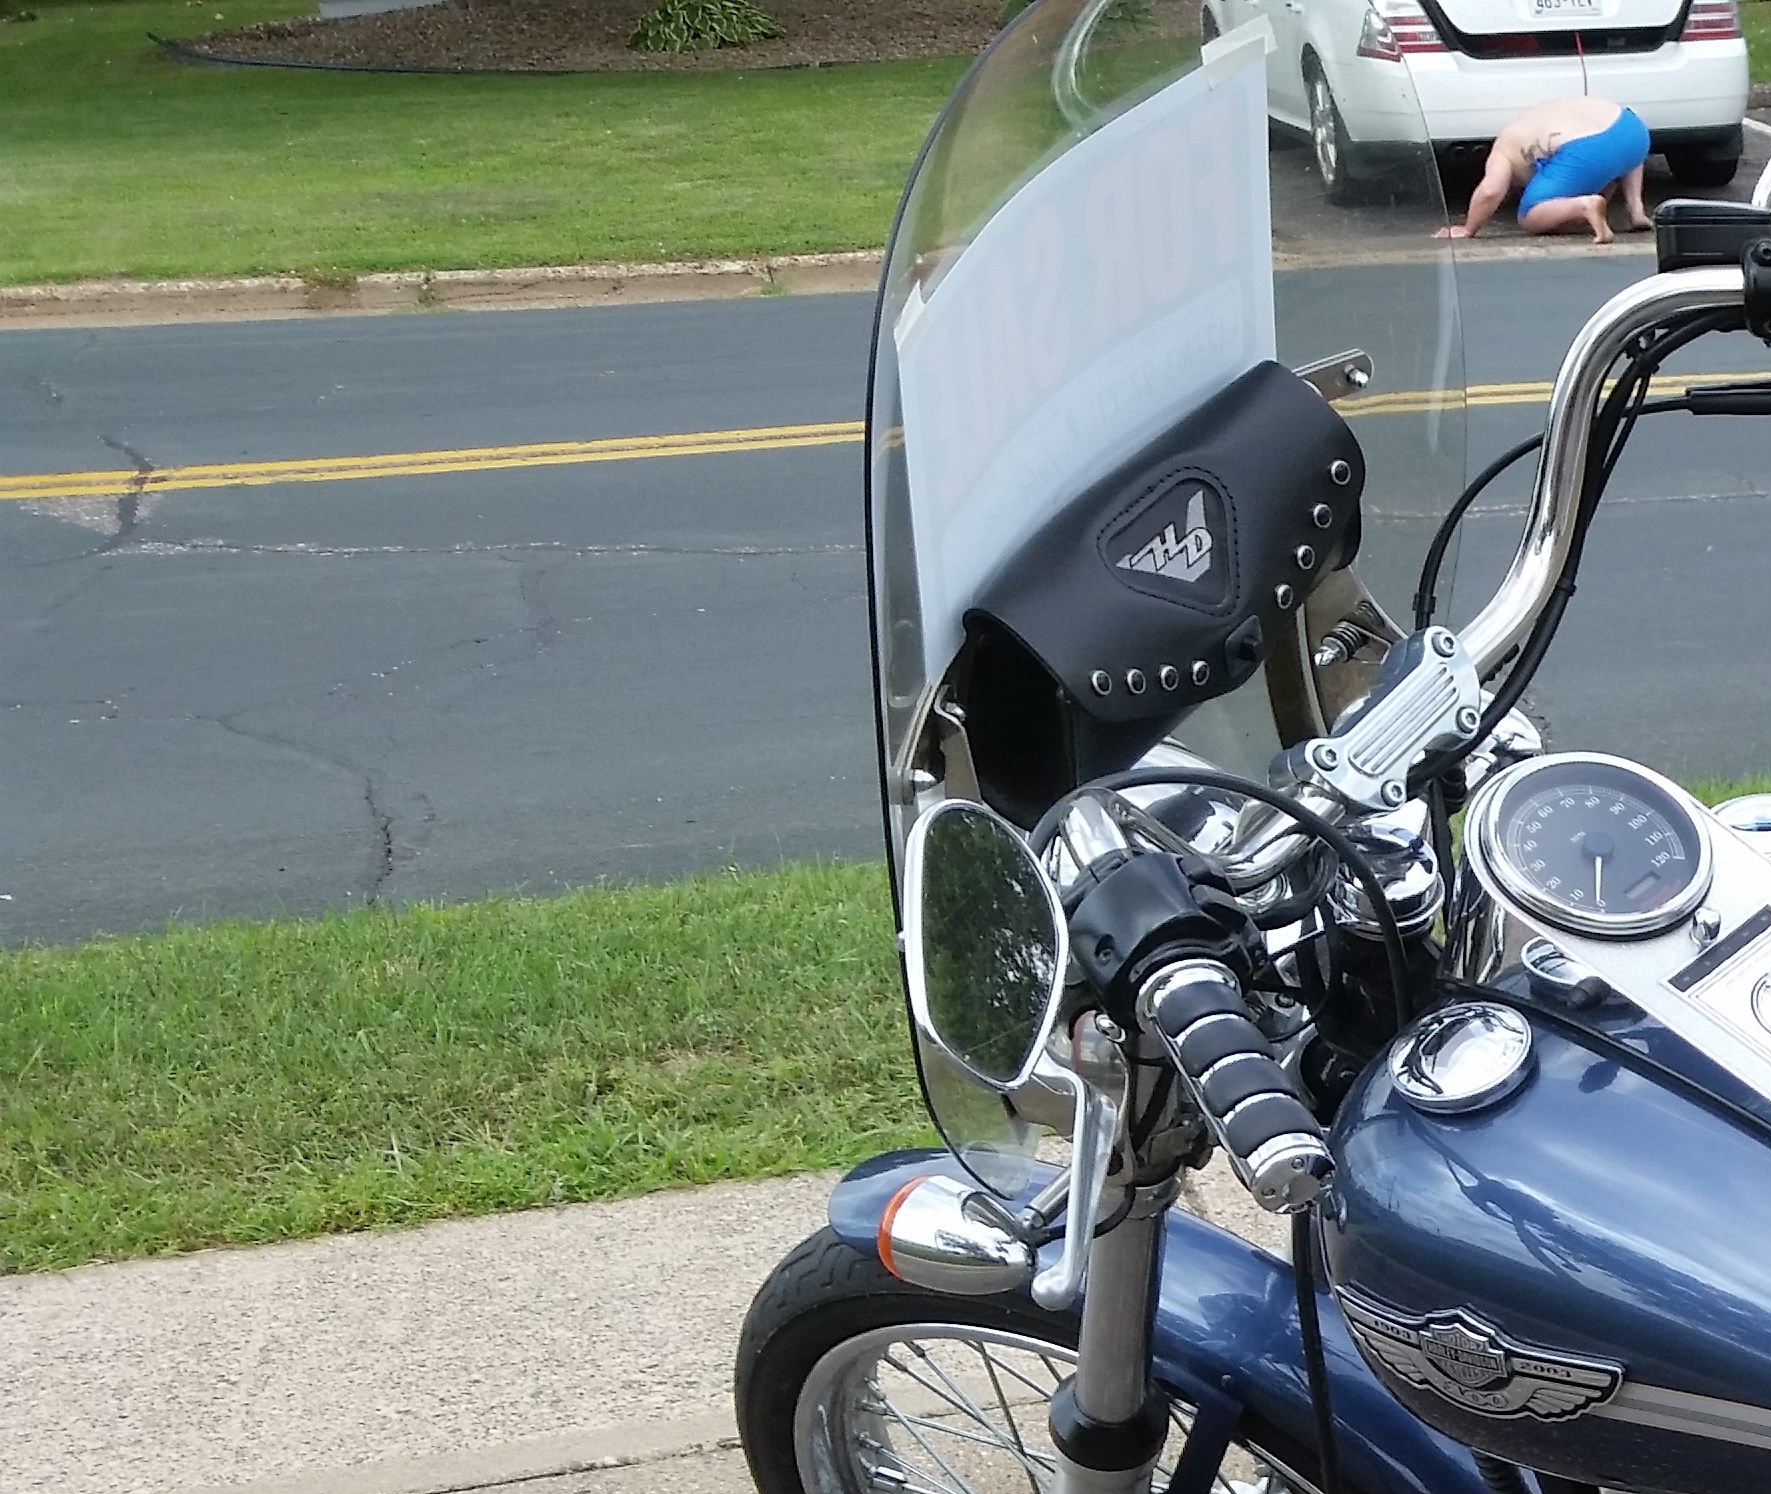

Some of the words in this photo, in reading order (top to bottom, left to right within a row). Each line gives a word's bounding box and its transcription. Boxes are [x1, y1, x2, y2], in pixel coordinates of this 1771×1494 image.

[1560, 797, 1576, 808] 70
[1584, 796, 1600, 808] 80
[1609, 802, 1626, 815] 90
[1536, 805, 1554, 818] 60
[1526, 821, 1542, 834] 50
[1628, 814, 1648, 830] 100
[1644, 831, 1663, 846] 110
[1523, 840, 1538, 852] 40
[1531, 859, 1546, 872] 30
[1650, 851, 1670, 868] 120
[1546, 876, 1562, 889] 20
[1570, 889, 1585, 901] 10
[1374, 1320, 1411, 1340] 1903
[1520, 1362, 1572, 1378] 2003
